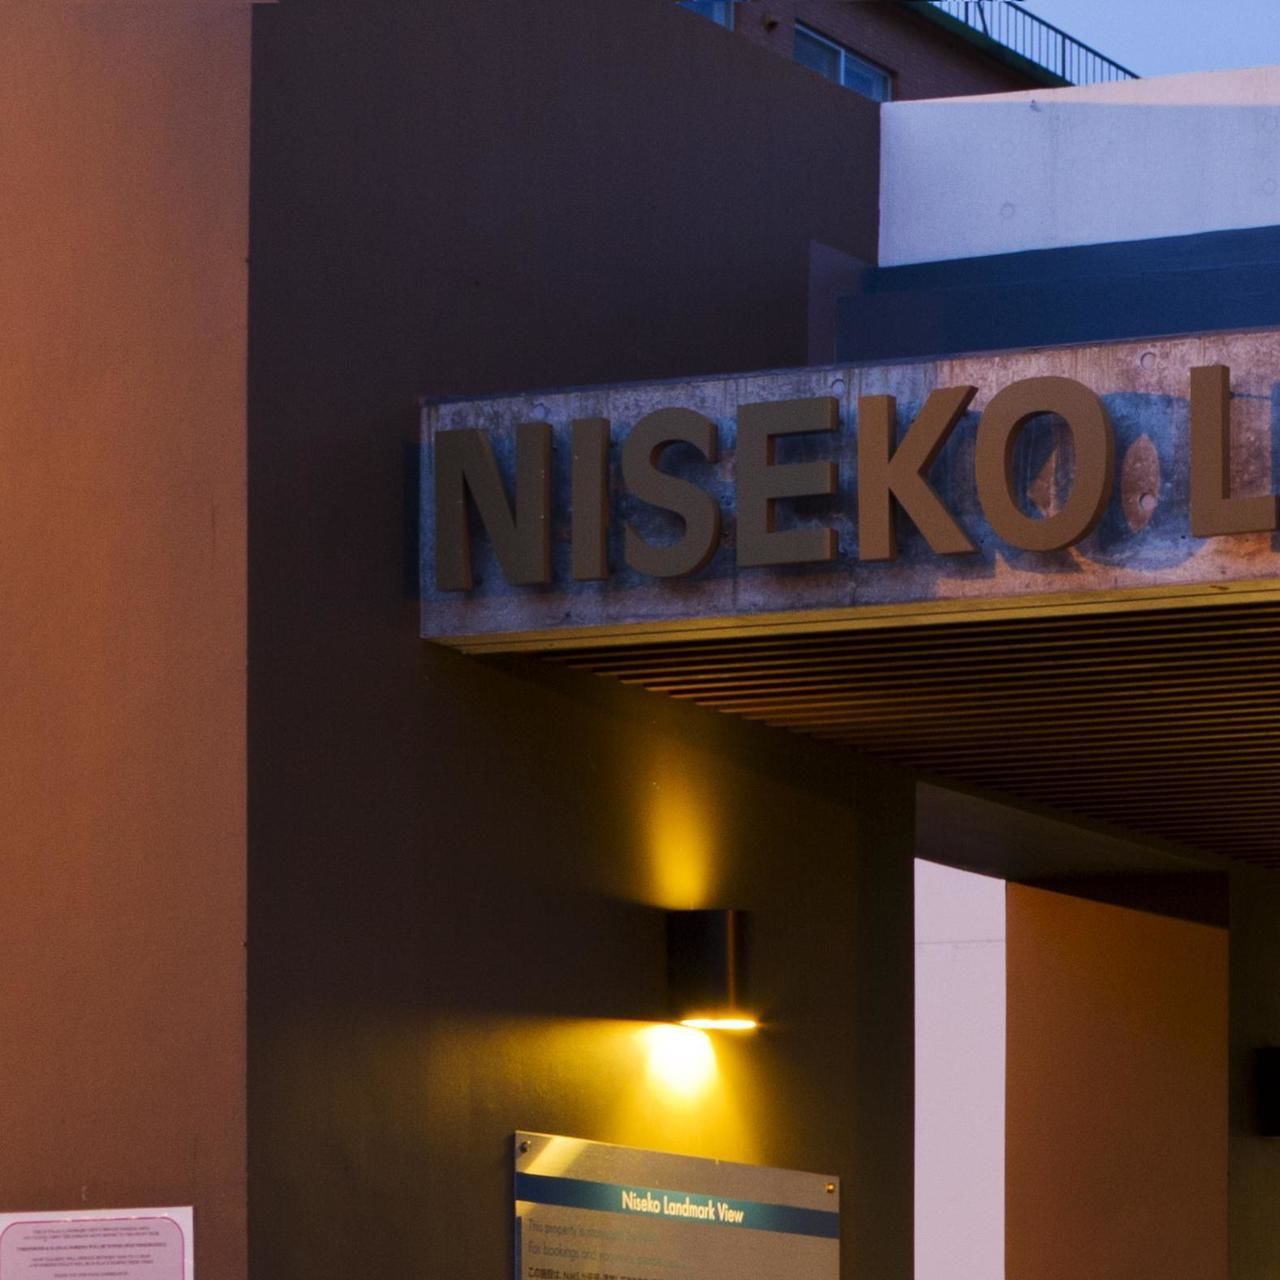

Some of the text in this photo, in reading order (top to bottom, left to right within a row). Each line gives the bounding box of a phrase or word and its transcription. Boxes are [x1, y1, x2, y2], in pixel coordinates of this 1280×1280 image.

[434, 375, 1116, 592] NISEKO
[621, 1189, 744, 1223] Niseko Landmark View
[543, 1241, 580, 1262] bookings
